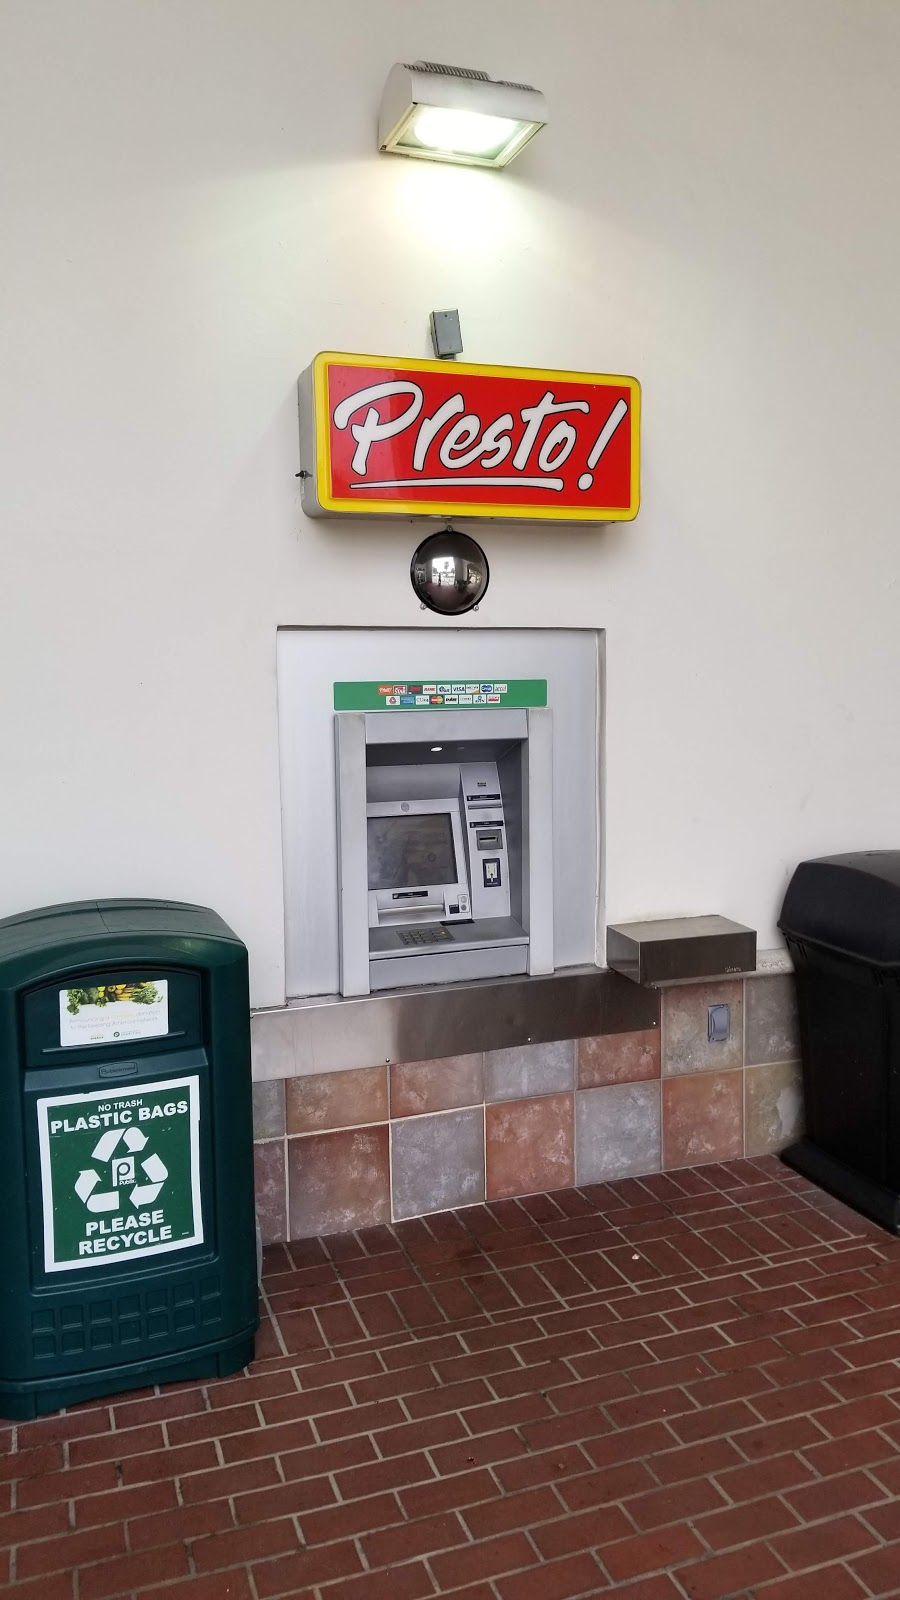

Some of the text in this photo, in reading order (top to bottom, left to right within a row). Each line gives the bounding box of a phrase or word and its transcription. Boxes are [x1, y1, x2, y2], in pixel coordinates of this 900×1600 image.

[333, 380, 629, 492] Presto!
[51, 1100, 188, 1134] PLASTIC BAGS
[98, 1099, 143, 1113] NO TRASH
[119, 1178, 136, 1186] Publix
[86, 1210, 165, 1237] PLEASE
[79, 1226, 173, 1256] RECYCLE
